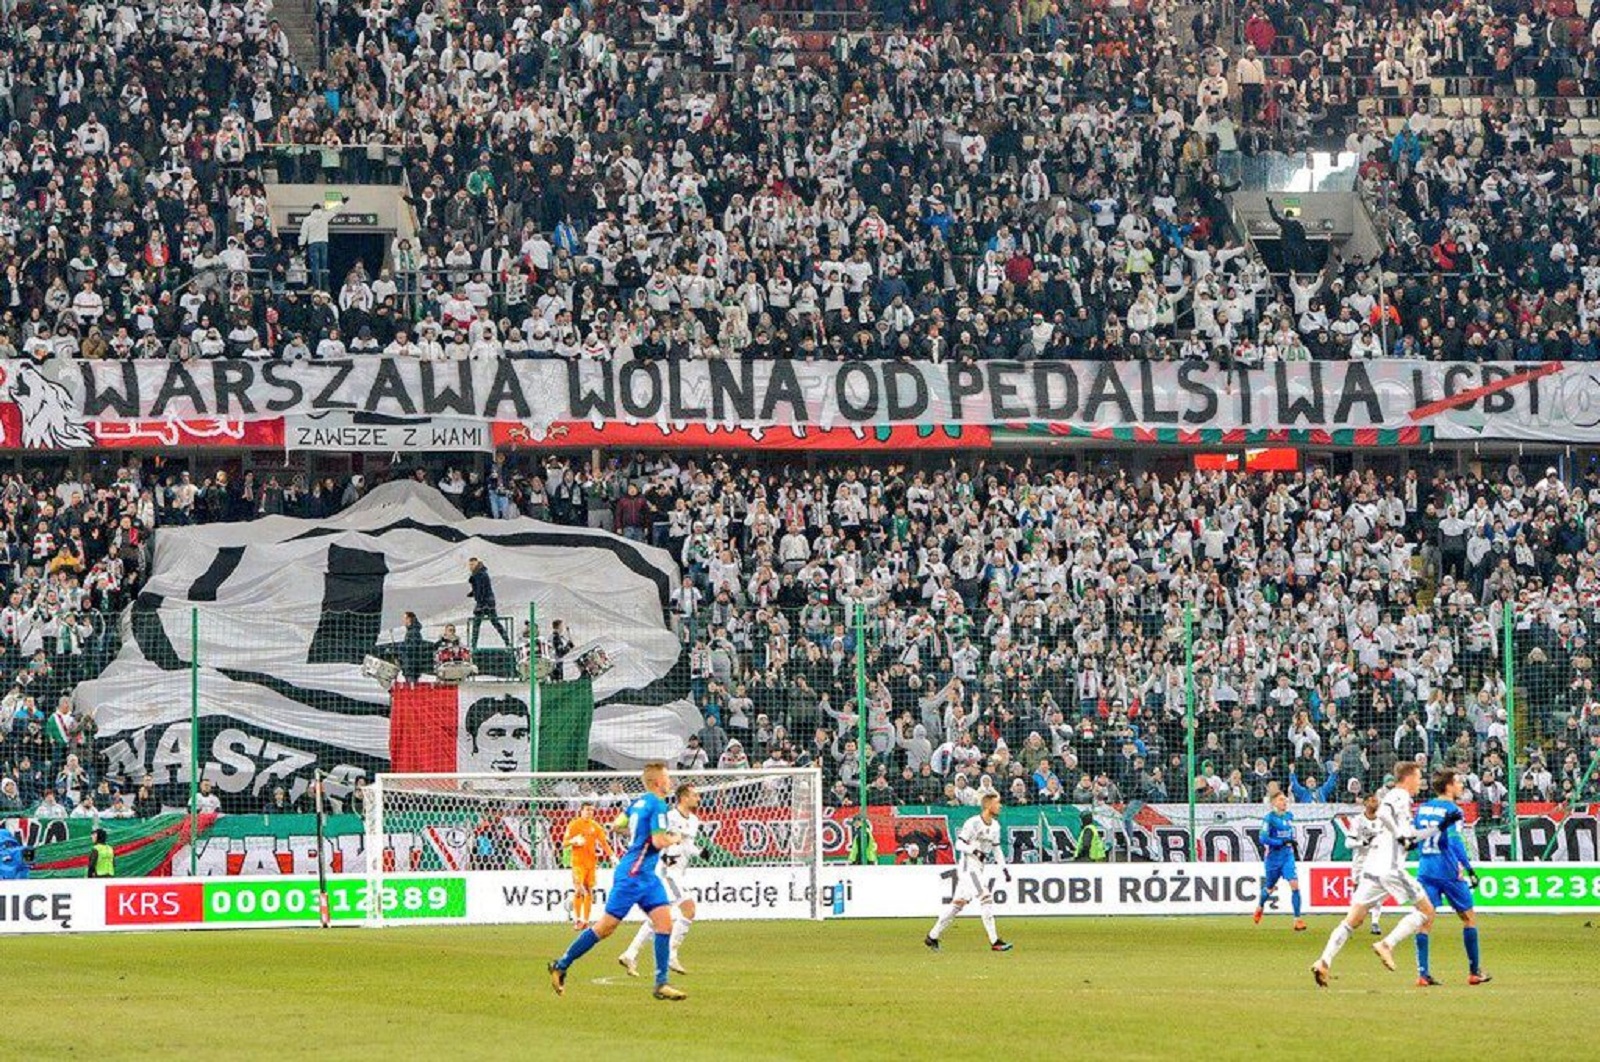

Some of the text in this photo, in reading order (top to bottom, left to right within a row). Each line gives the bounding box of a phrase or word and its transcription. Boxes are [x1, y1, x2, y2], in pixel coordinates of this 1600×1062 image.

[77, 358, 532, 418] WARSZAWA
[566, 357, 809, 421] WOLNA
[836, 361, 929, 421] OD
[947, 359, 1384, 424] PEDALSTWA
[1412, 364, 1542, 415] LGBT
[297, 427, 482, 446] ZAWSZE Z WAMI
[118, 891, 181, 916] KRS
[690, 881, 778, 907] ndację
[788, 879, 852, 906] Legi
[1018, 876, 1103, 904] ROBI
[0, 893, 71, 929] ICĘ
